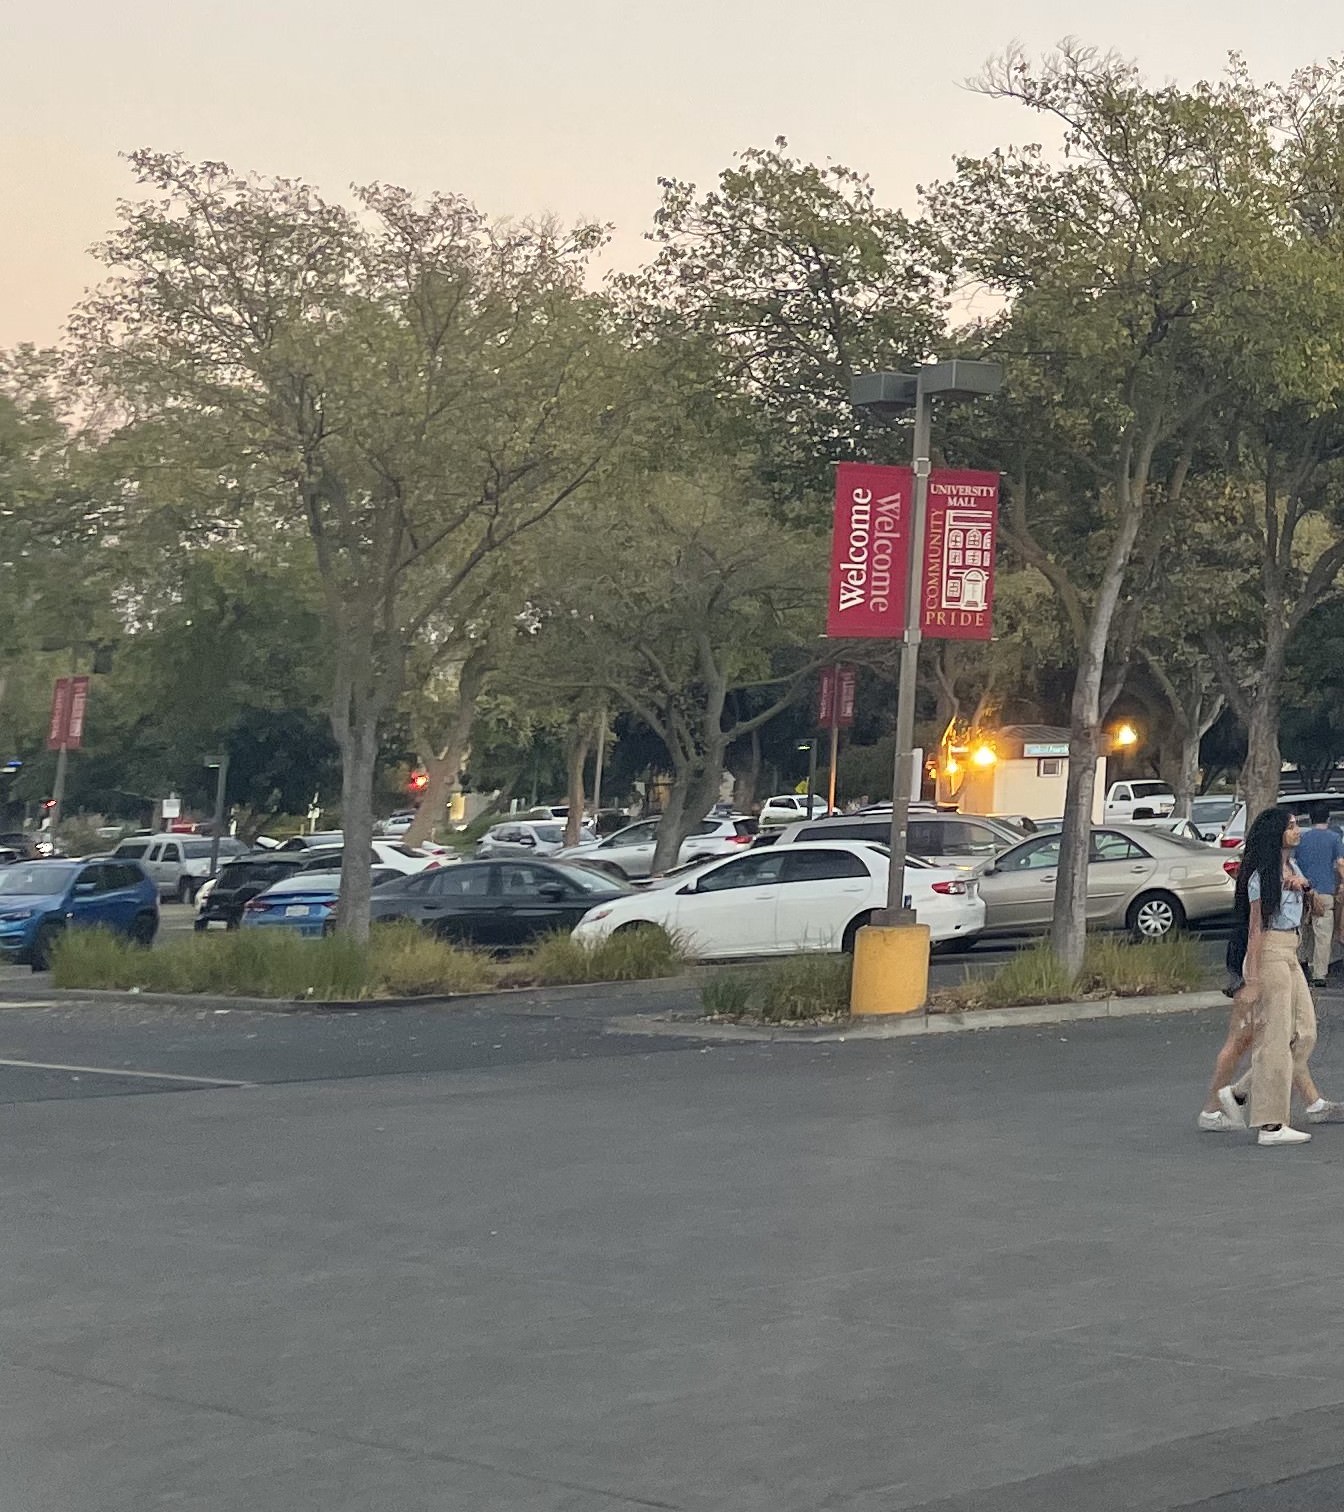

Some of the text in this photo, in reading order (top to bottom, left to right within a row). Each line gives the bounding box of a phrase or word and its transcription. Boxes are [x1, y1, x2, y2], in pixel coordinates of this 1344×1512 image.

[930, 484, 996, 497] UNIVERSITY
[947, 496, 977, 507] MALL
[839, 487, 872, 612] Welcome
[869, 492, 901, 613] Welcome
[926, 508, 944, 610] COMMUNITY
[926, 611, 985, 627] PRIDE
